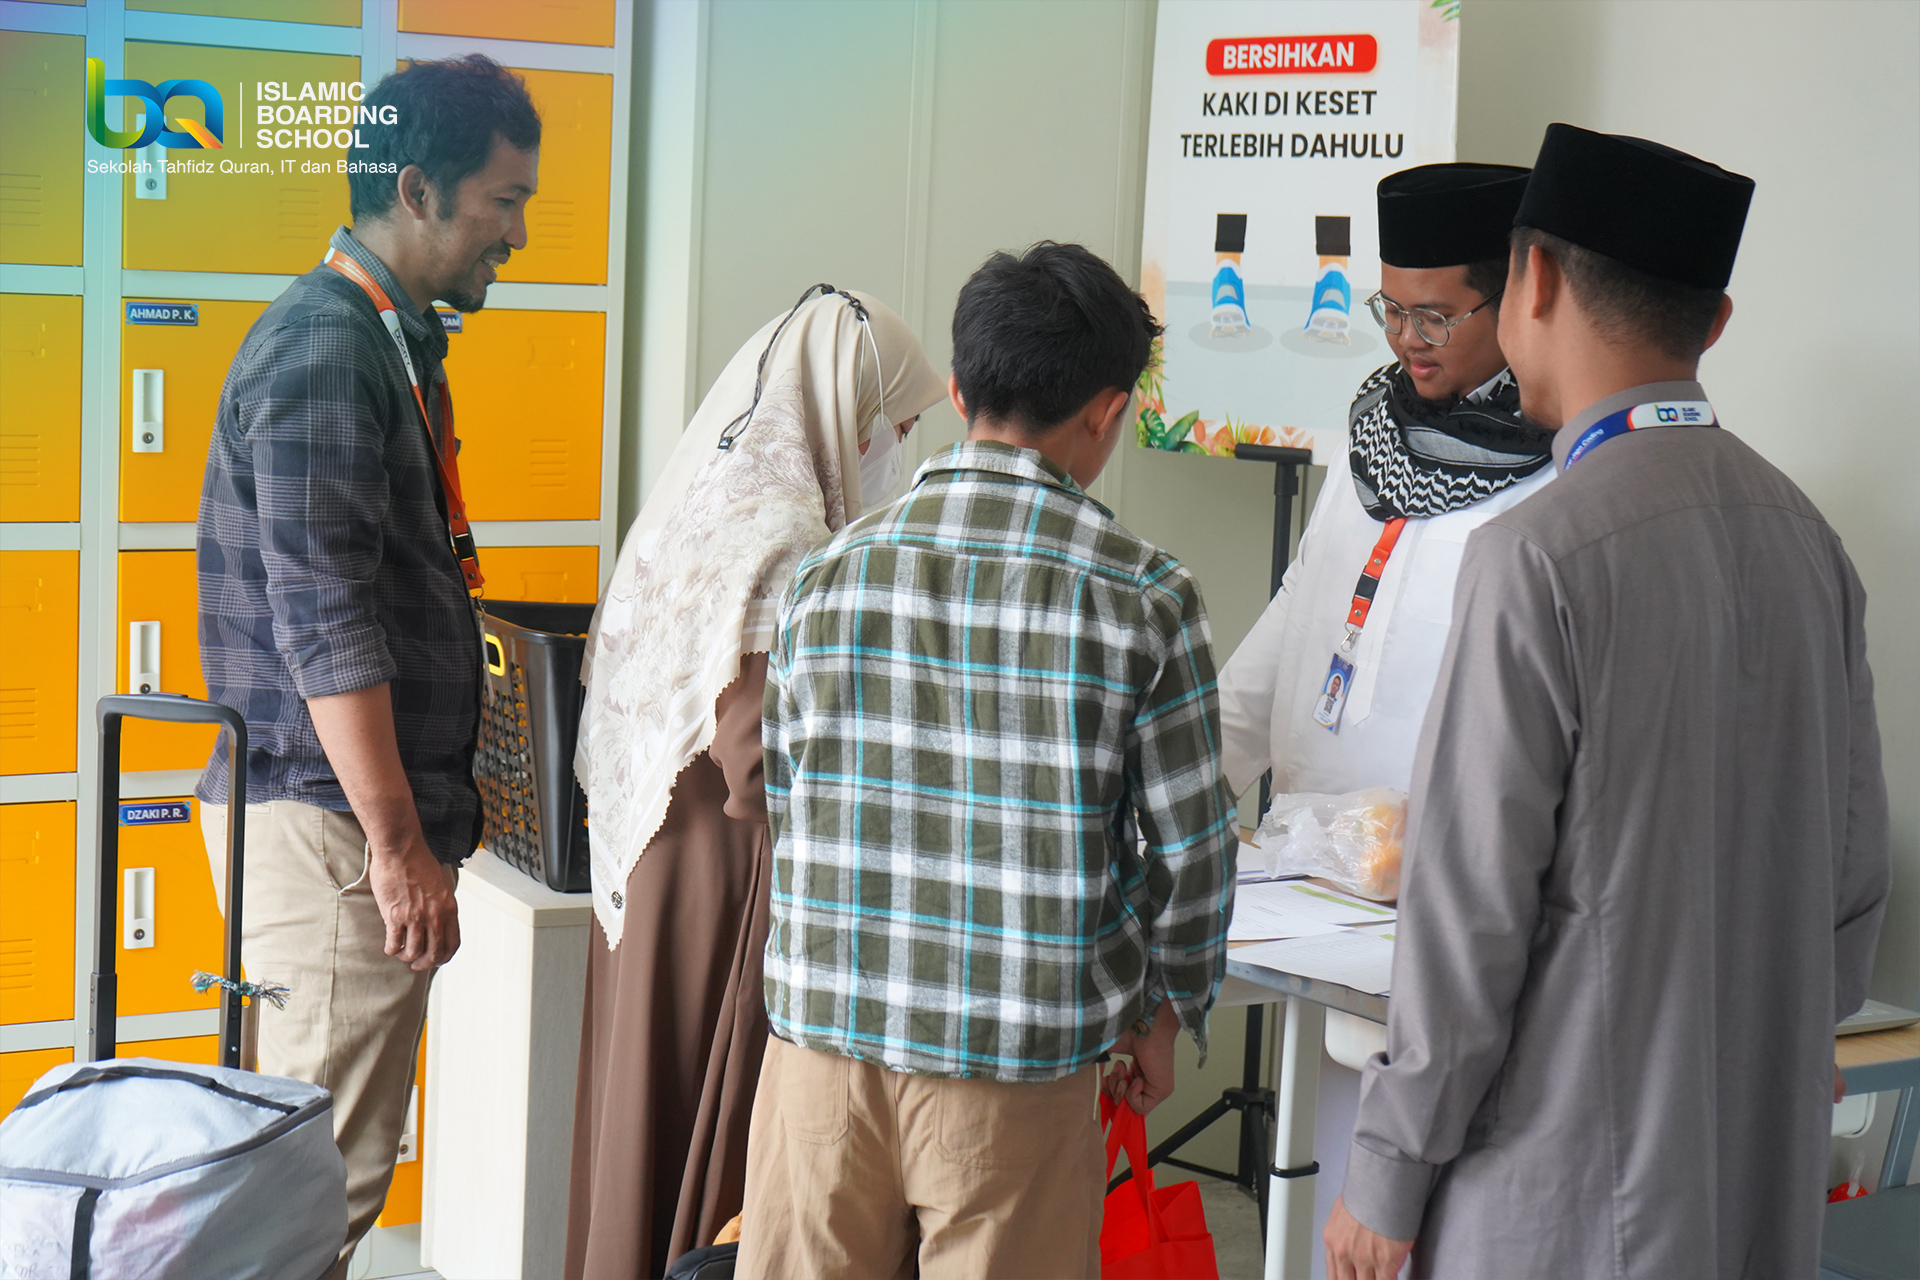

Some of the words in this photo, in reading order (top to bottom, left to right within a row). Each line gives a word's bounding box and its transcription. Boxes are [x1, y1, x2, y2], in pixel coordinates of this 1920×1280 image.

[1223, 42, 1354, 69] BERSIHKAN
[1203, 92, 1257, 116] KAKI
[1264, 91, 1289, 116] DI
[1296, 90, 1377, 115] KESET
[1181, 134, 1283, 158] TERLEBIH
[1291, 133, 1404, 158] DAHULU
[130, 308, 171, 319] AHMAD
[172, 309, 182, 320] P.
[184, 309, 195, 320] K.
[127, 809, 160, 820] DZAKI
[161, 808, 171, 818] P.
[173, 808, 183, 818] R.
